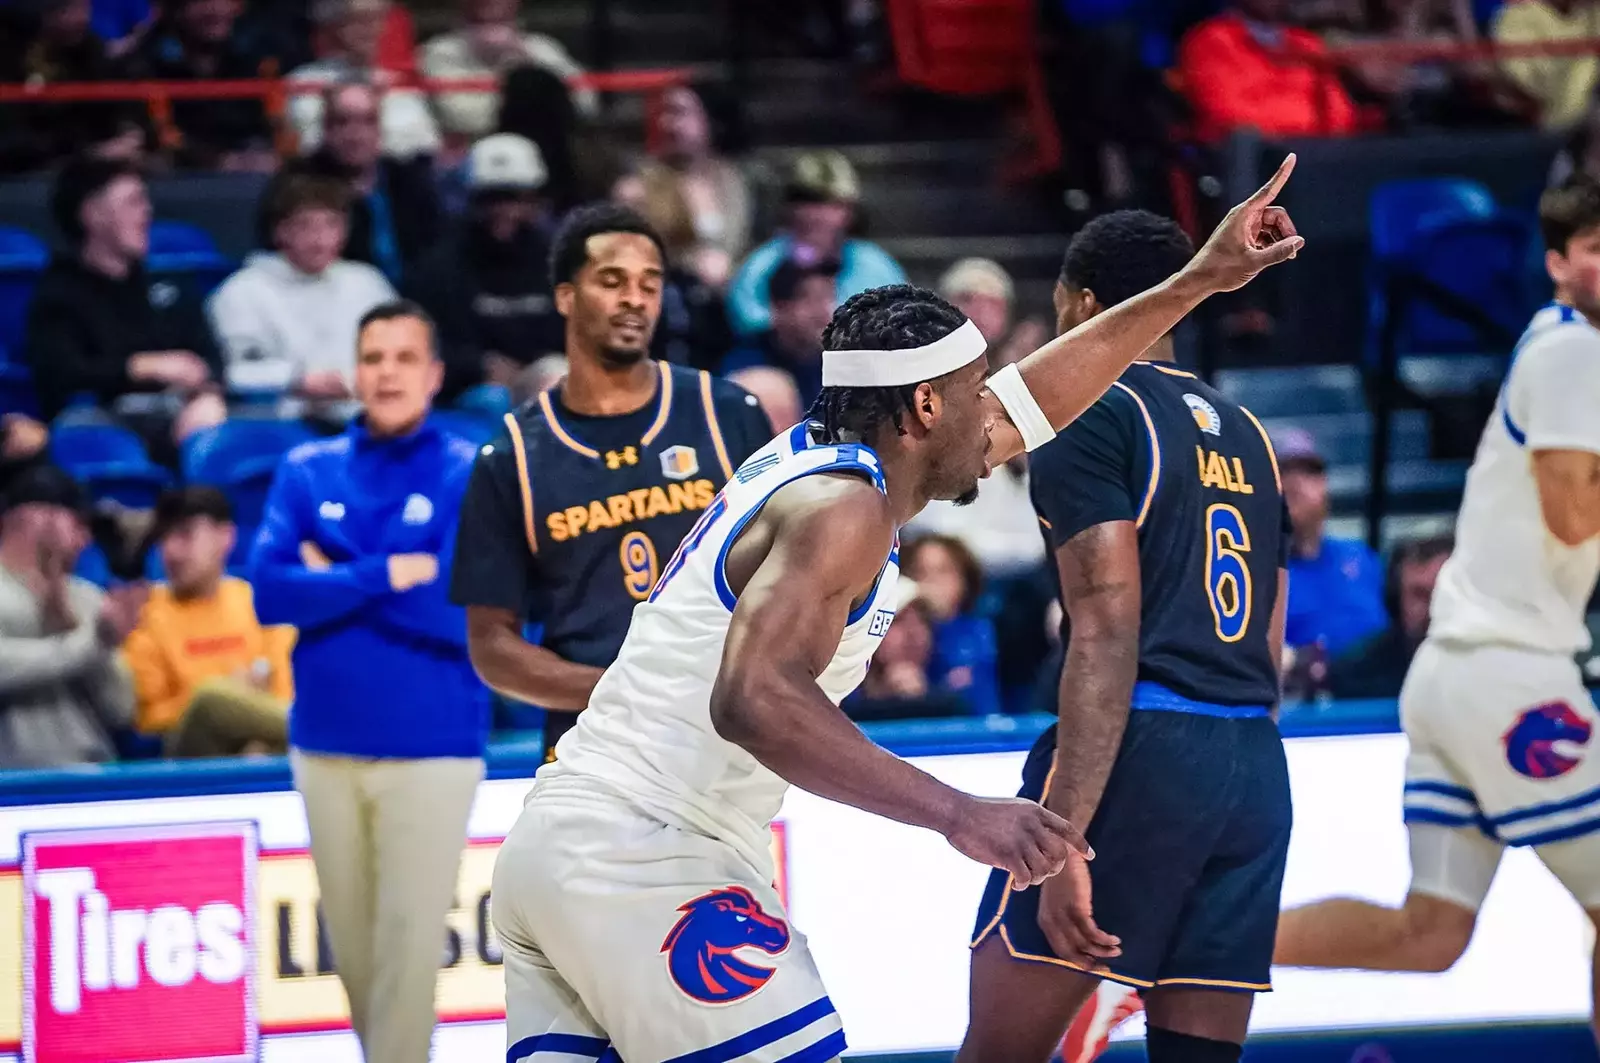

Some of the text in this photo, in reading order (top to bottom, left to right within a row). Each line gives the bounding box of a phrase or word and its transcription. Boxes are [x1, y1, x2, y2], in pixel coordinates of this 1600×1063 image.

[546, 479, 715, 541] SPARTANS
[619, 531, 659, 600] 9
[1205, 503, 1252, 642] 6
[35, 867, 247, 1014] Tires
